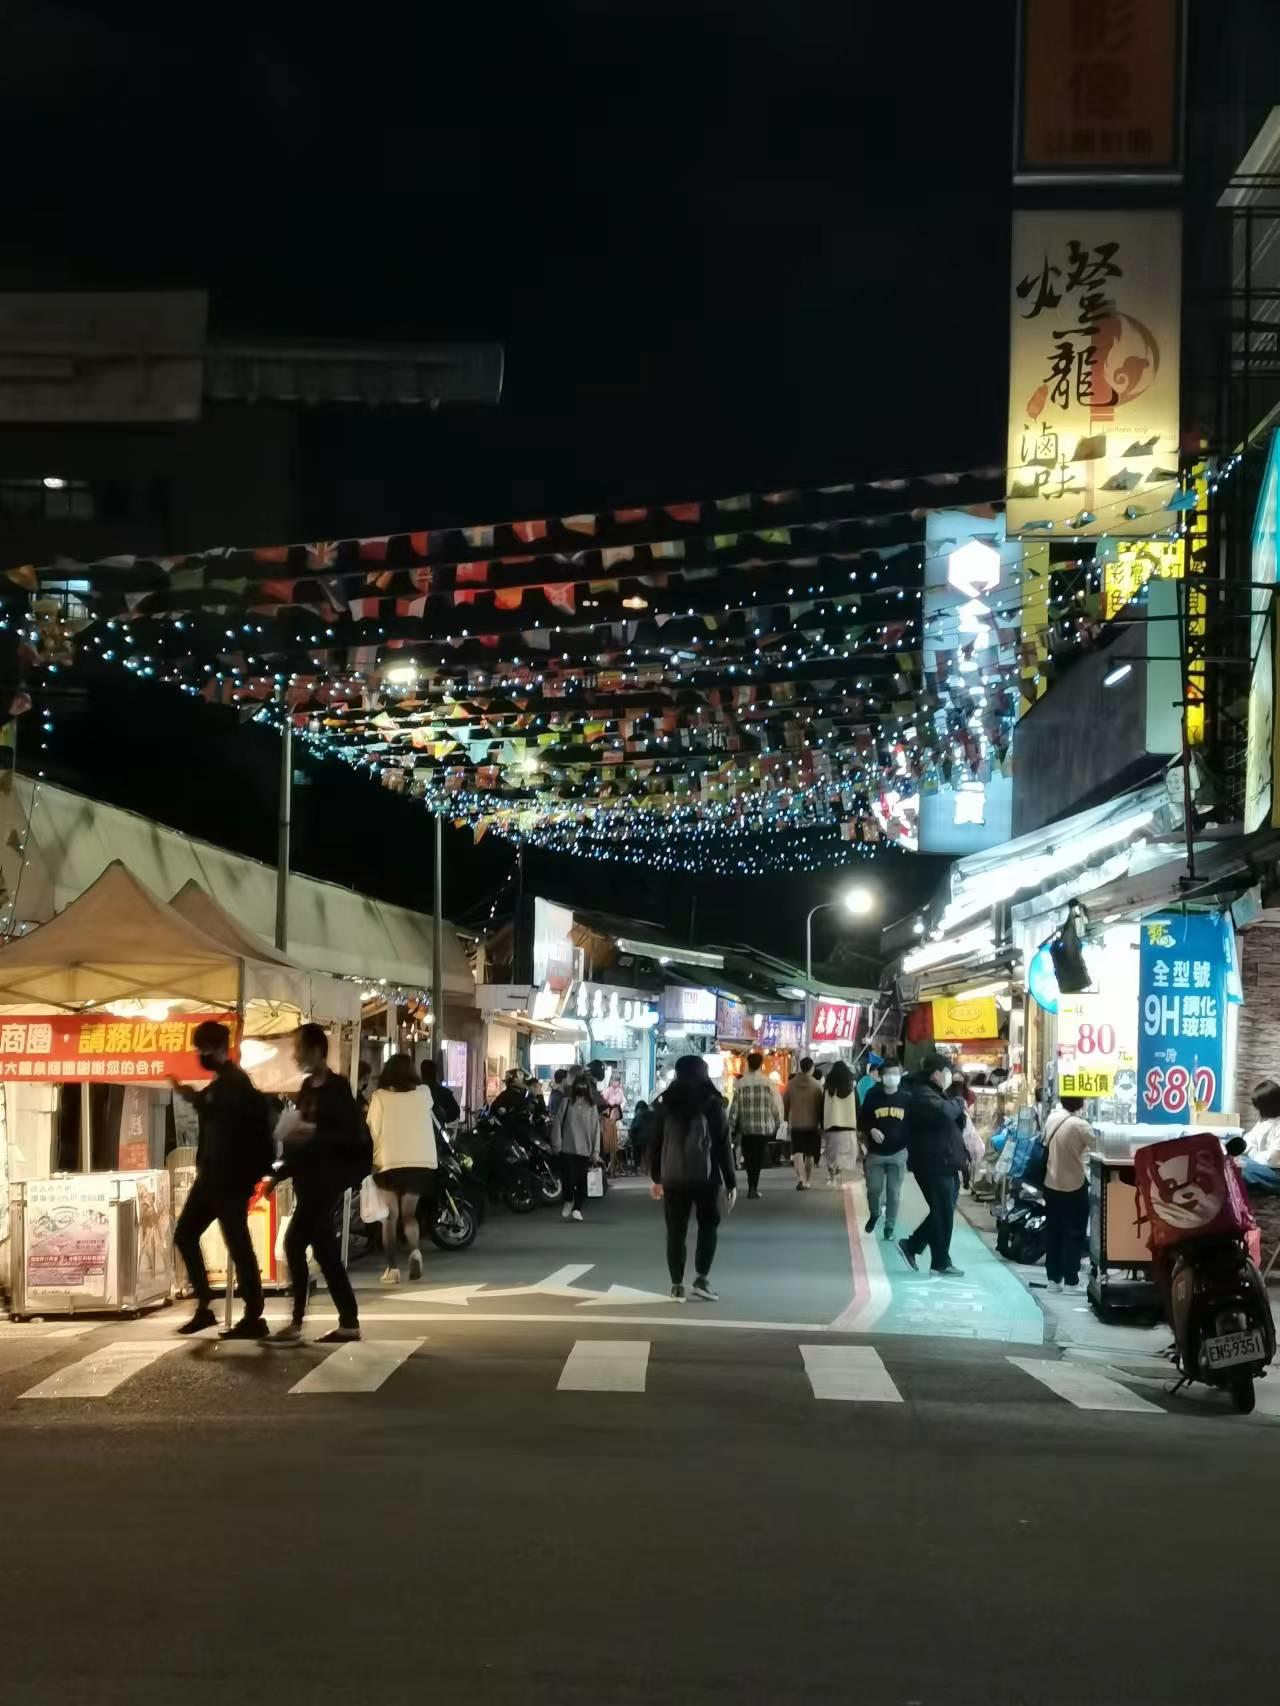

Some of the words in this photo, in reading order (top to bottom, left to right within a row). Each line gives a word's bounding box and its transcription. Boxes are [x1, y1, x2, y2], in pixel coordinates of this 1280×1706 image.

[1152, 959, 1212, 988] 全型號
[1144, 994, 1180, 1037] 9H
[1182, 994, 1217, 1017] 鋼化
[1182, 1016, 1217, 1038] 玻璃
[1077, 1023, 1116, 1055] 80
[1062, 1073, 1109, 1093] 自貼價
[1143, 1064, 1216, 1114] $80
